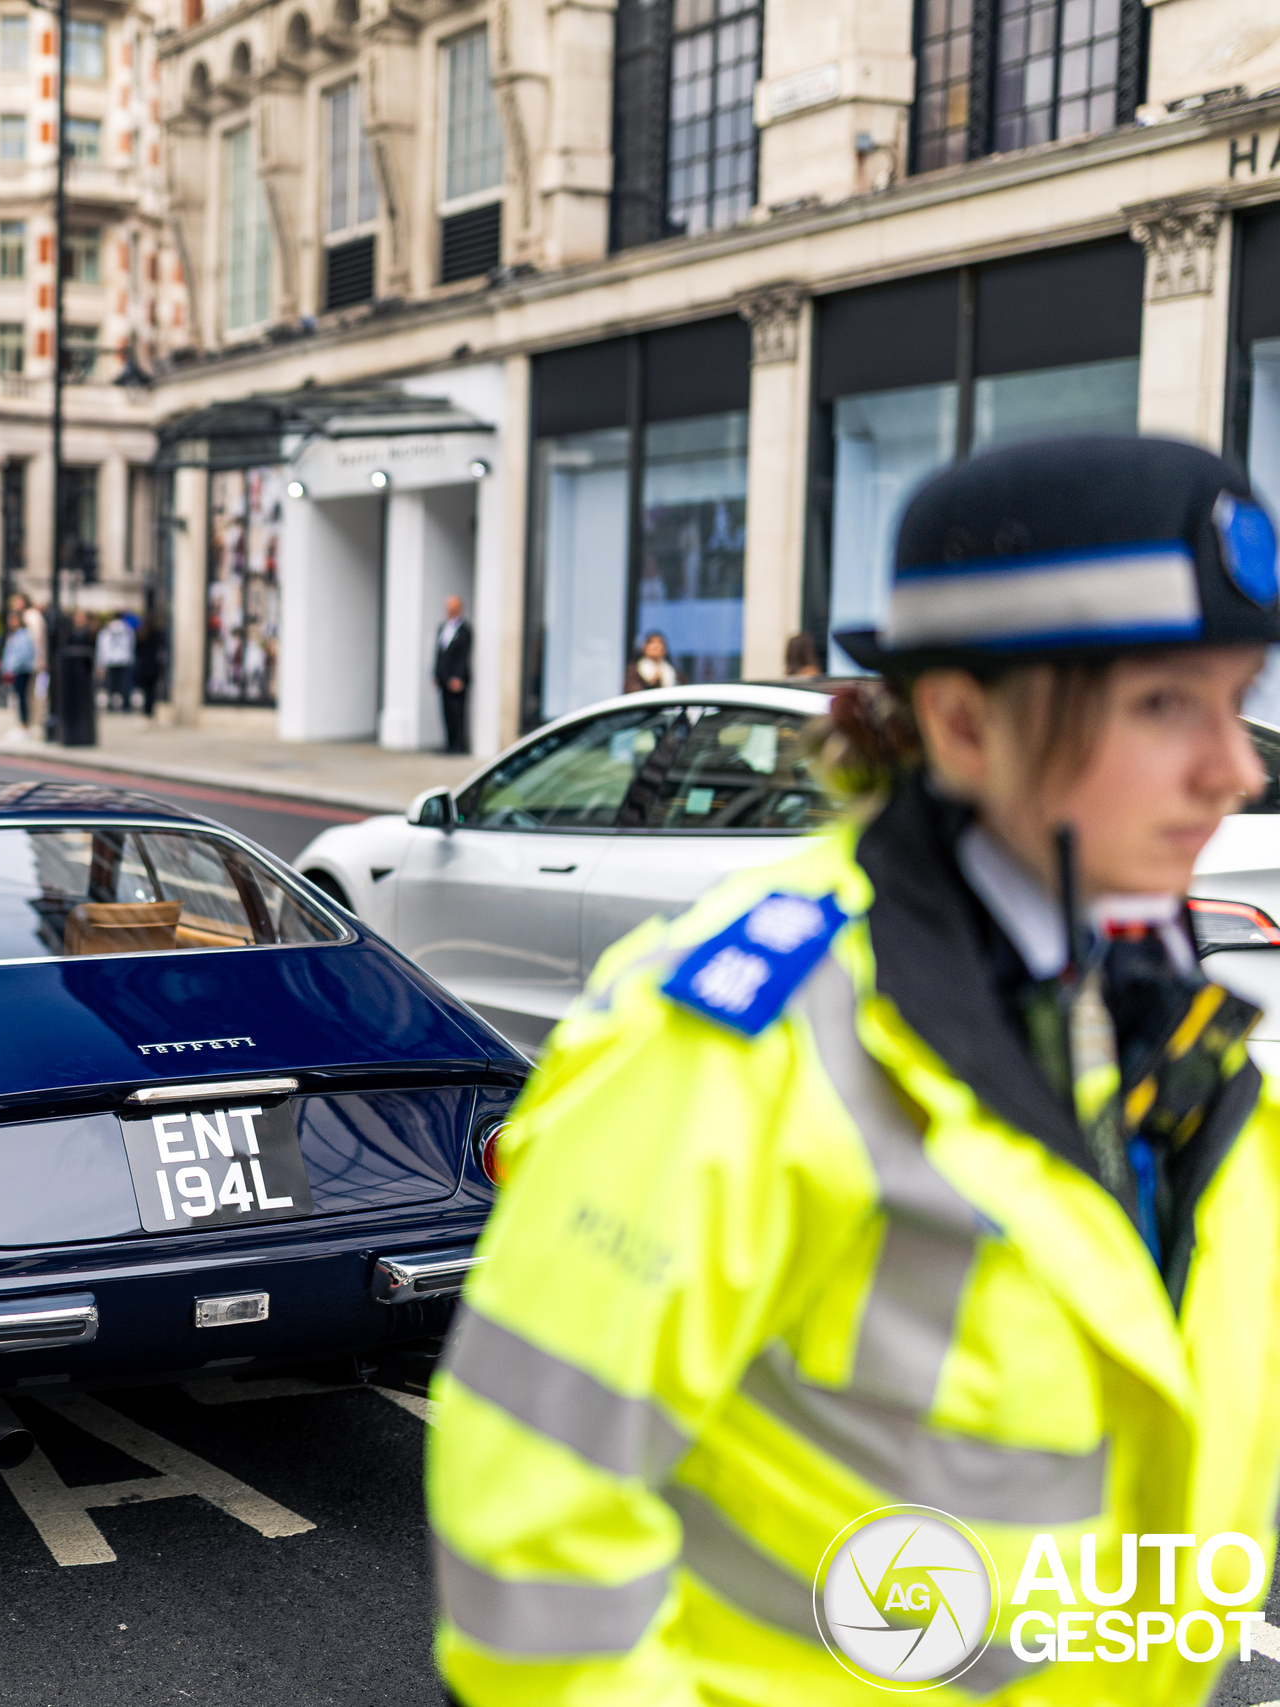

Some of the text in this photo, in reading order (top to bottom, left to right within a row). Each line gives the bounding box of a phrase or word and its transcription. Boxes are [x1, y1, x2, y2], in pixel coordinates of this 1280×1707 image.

[137, 1037, 256, 1055] Ferrari
[152, 1105, 263, 1164] ENT
[156, 1159, 294, 1221] 194L
